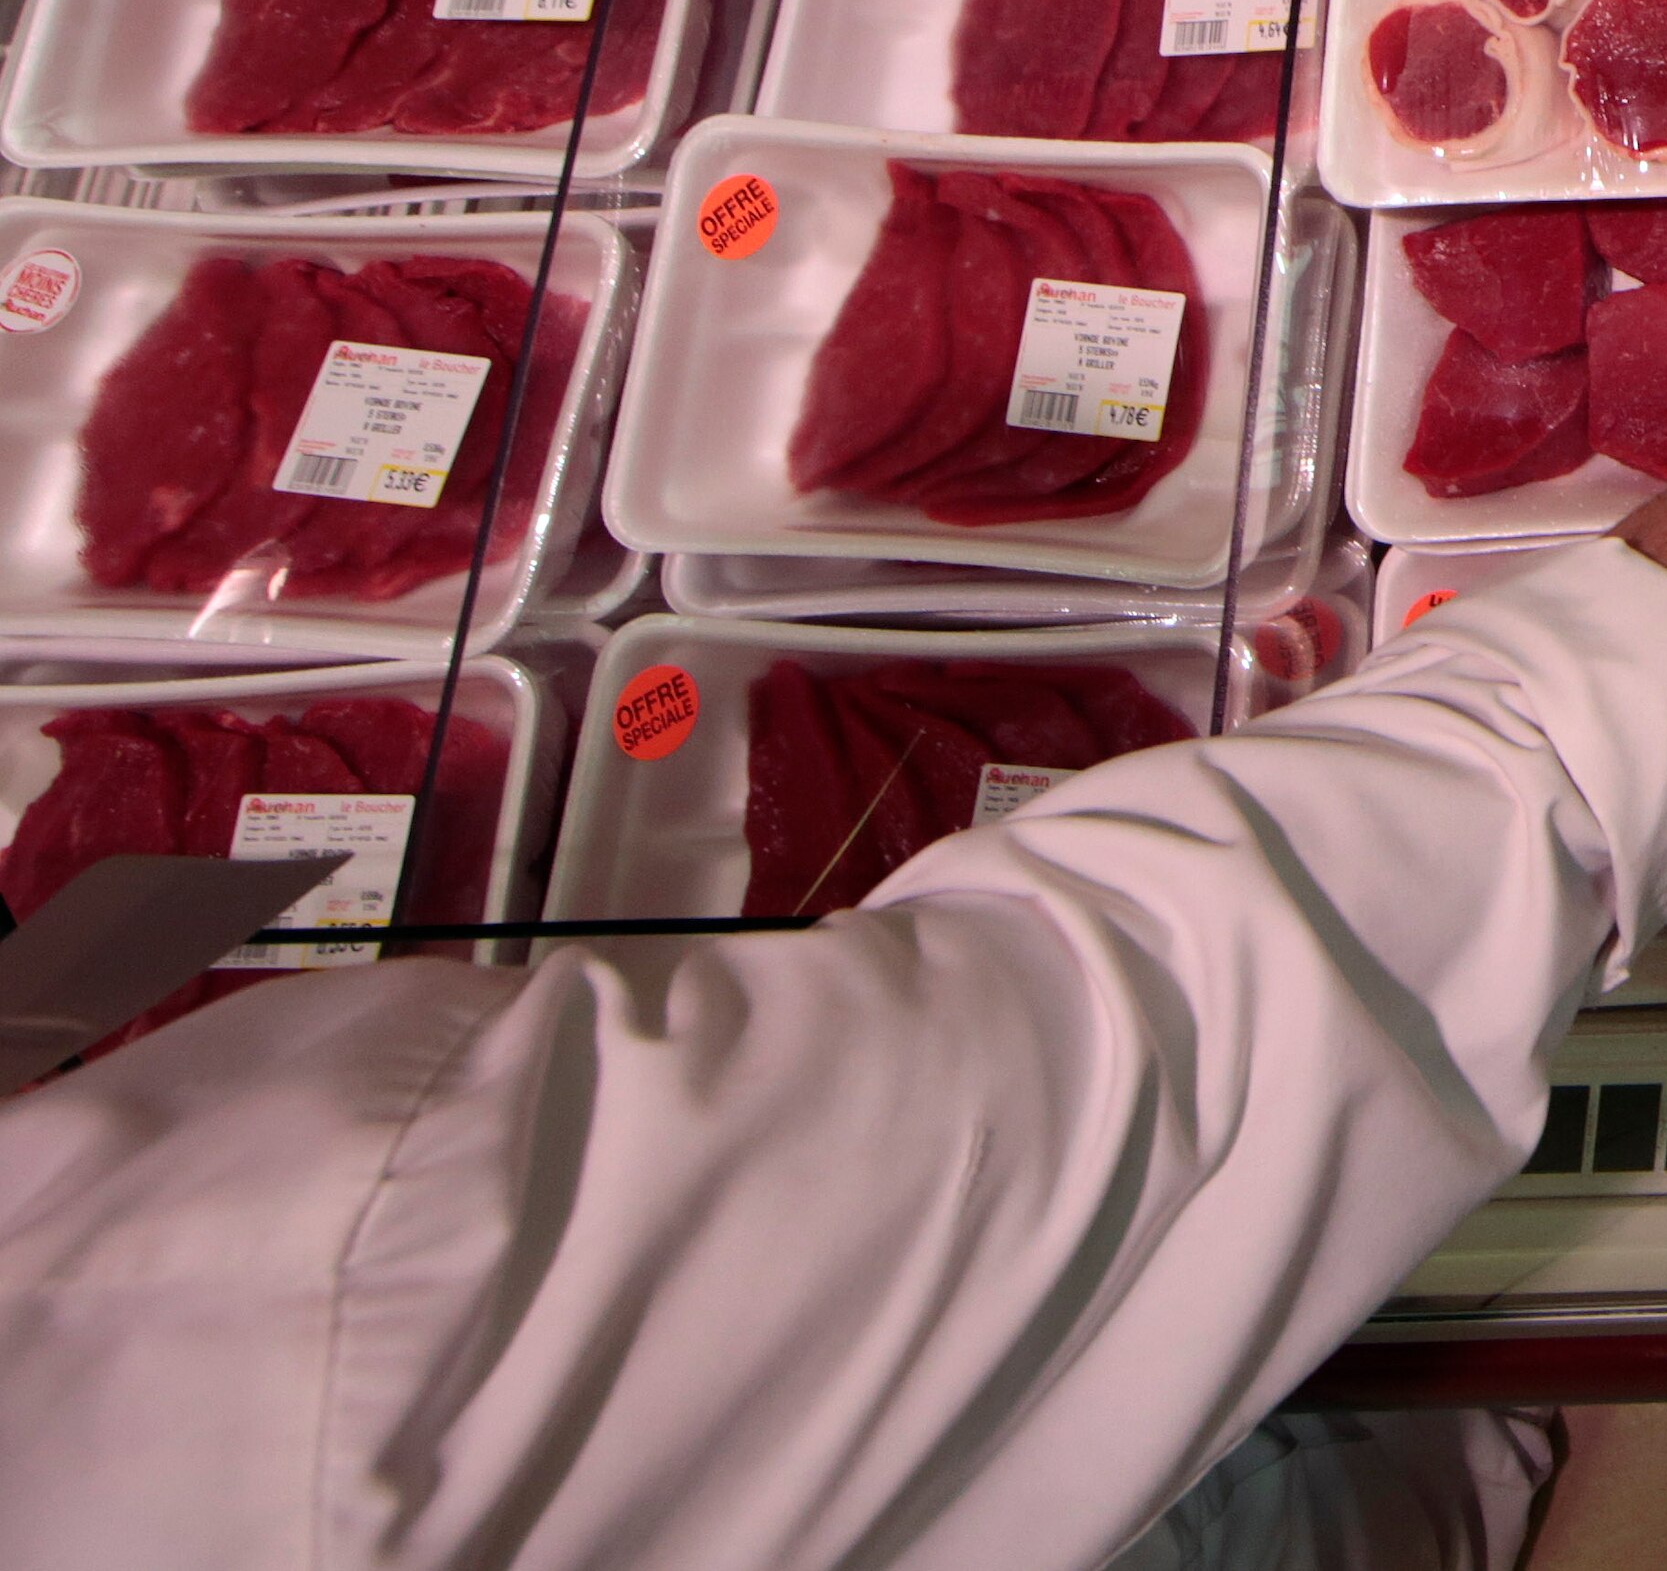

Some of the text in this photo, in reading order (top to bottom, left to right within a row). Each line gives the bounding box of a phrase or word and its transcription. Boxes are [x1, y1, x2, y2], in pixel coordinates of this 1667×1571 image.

[701, 178, 765, 237] OFFRE
[711, 198, 775, 254] SPECIALE
[1109, 406, 1149, 427] 4,78€
[616, 673, 691, 730] OFFRE
[622, 698, 694, 752] SPECIALE
